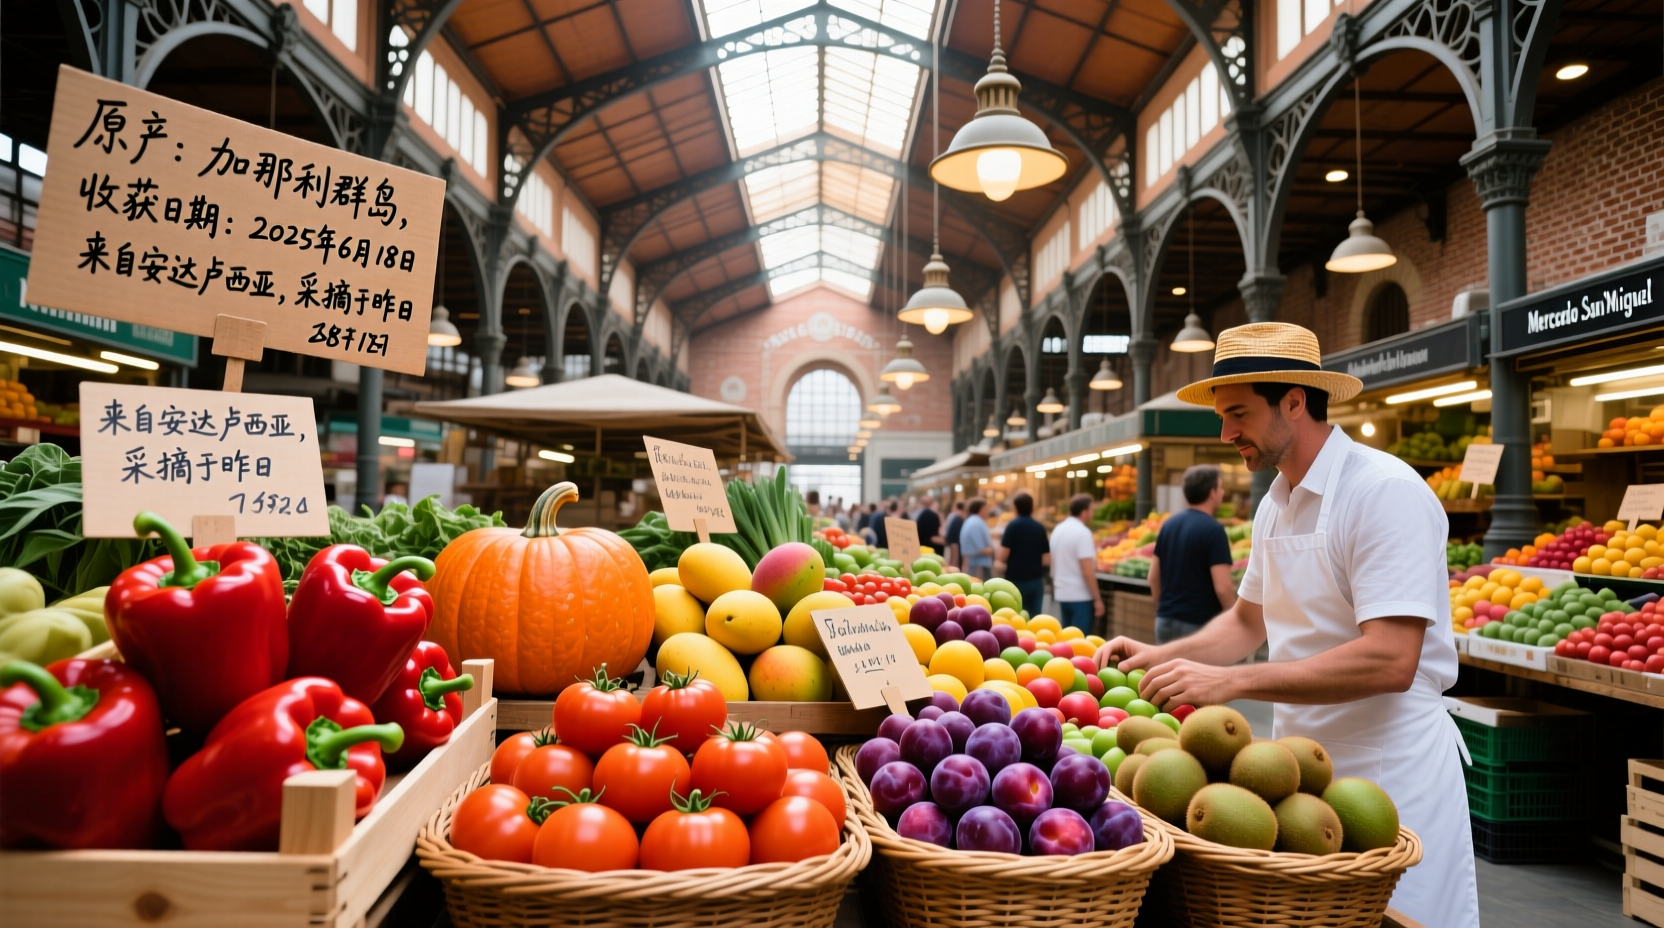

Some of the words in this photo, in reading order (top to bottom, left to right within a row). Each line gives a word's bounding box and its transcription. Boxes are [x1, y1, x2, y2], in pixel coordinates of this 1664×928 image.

[97, 398, 306, 443] 来自安达卢西亚，
[121, 446, 272, 484] 采摘于昨日
